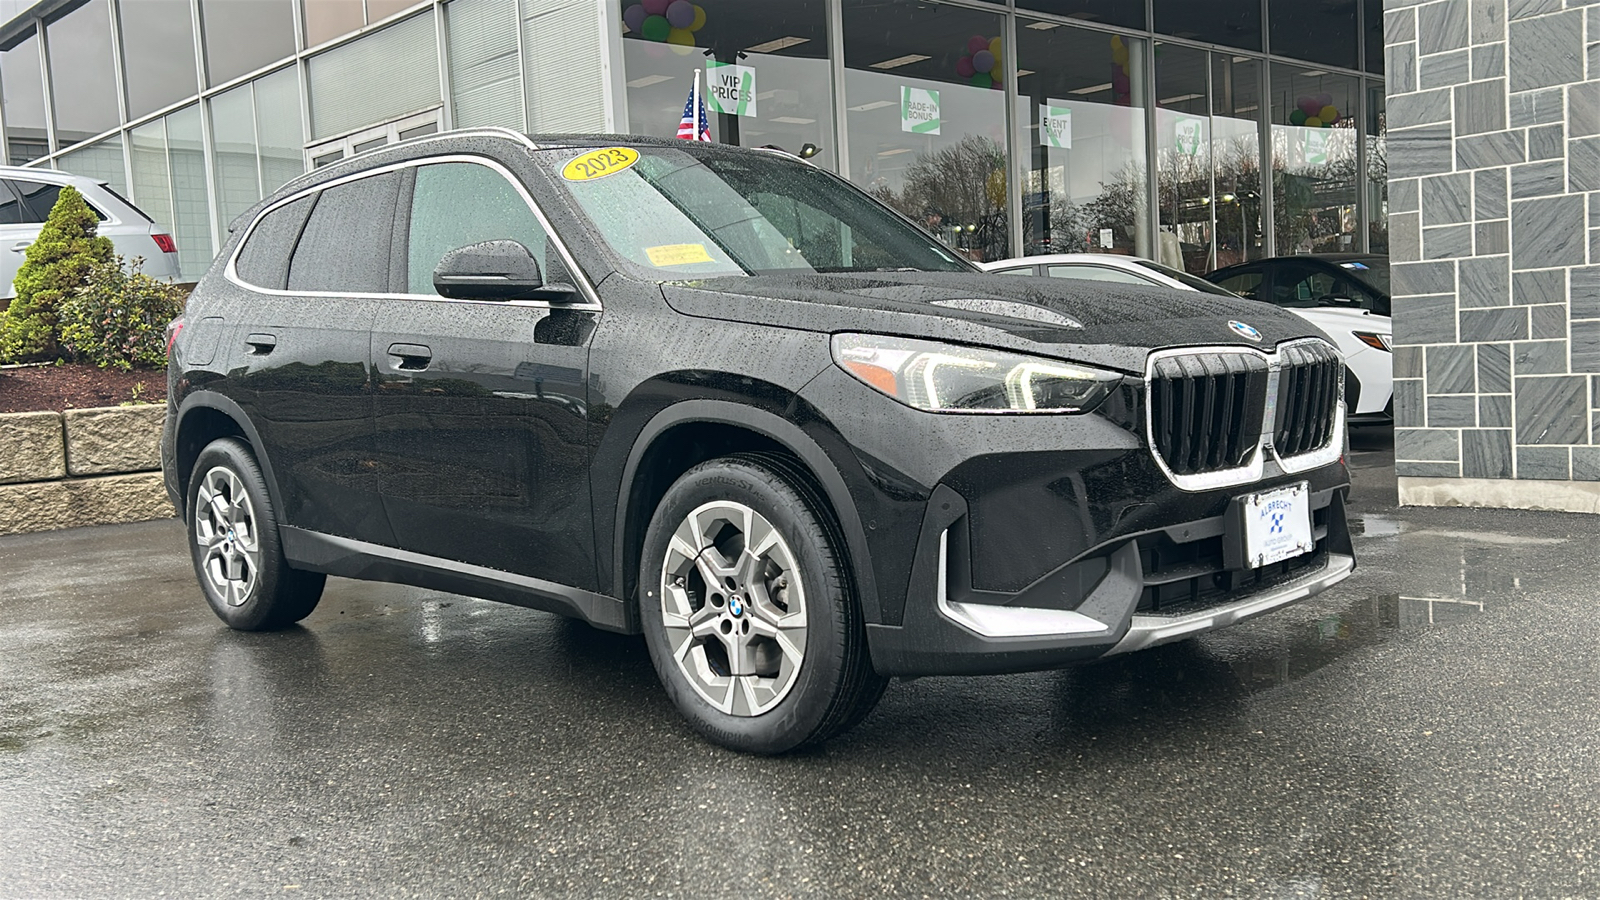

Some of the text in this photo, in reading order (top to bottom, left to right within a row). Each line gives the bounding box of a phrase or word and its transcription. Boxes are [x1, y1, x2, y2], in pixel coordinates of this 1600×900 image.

[721, 74, 741, 88] VIP
[711, 85, 752, 102] PRICES
[903, 100, 938, 113] TRADE-IN
[908, 110, 933, 121] BONUS
[1043, 117, 1067, 130] EVENT
[1183, 126, 1194, 135] VIP
[575, 149, 629, 177] 2023
[1260, 500, 1292, 520] ALBRECHT
